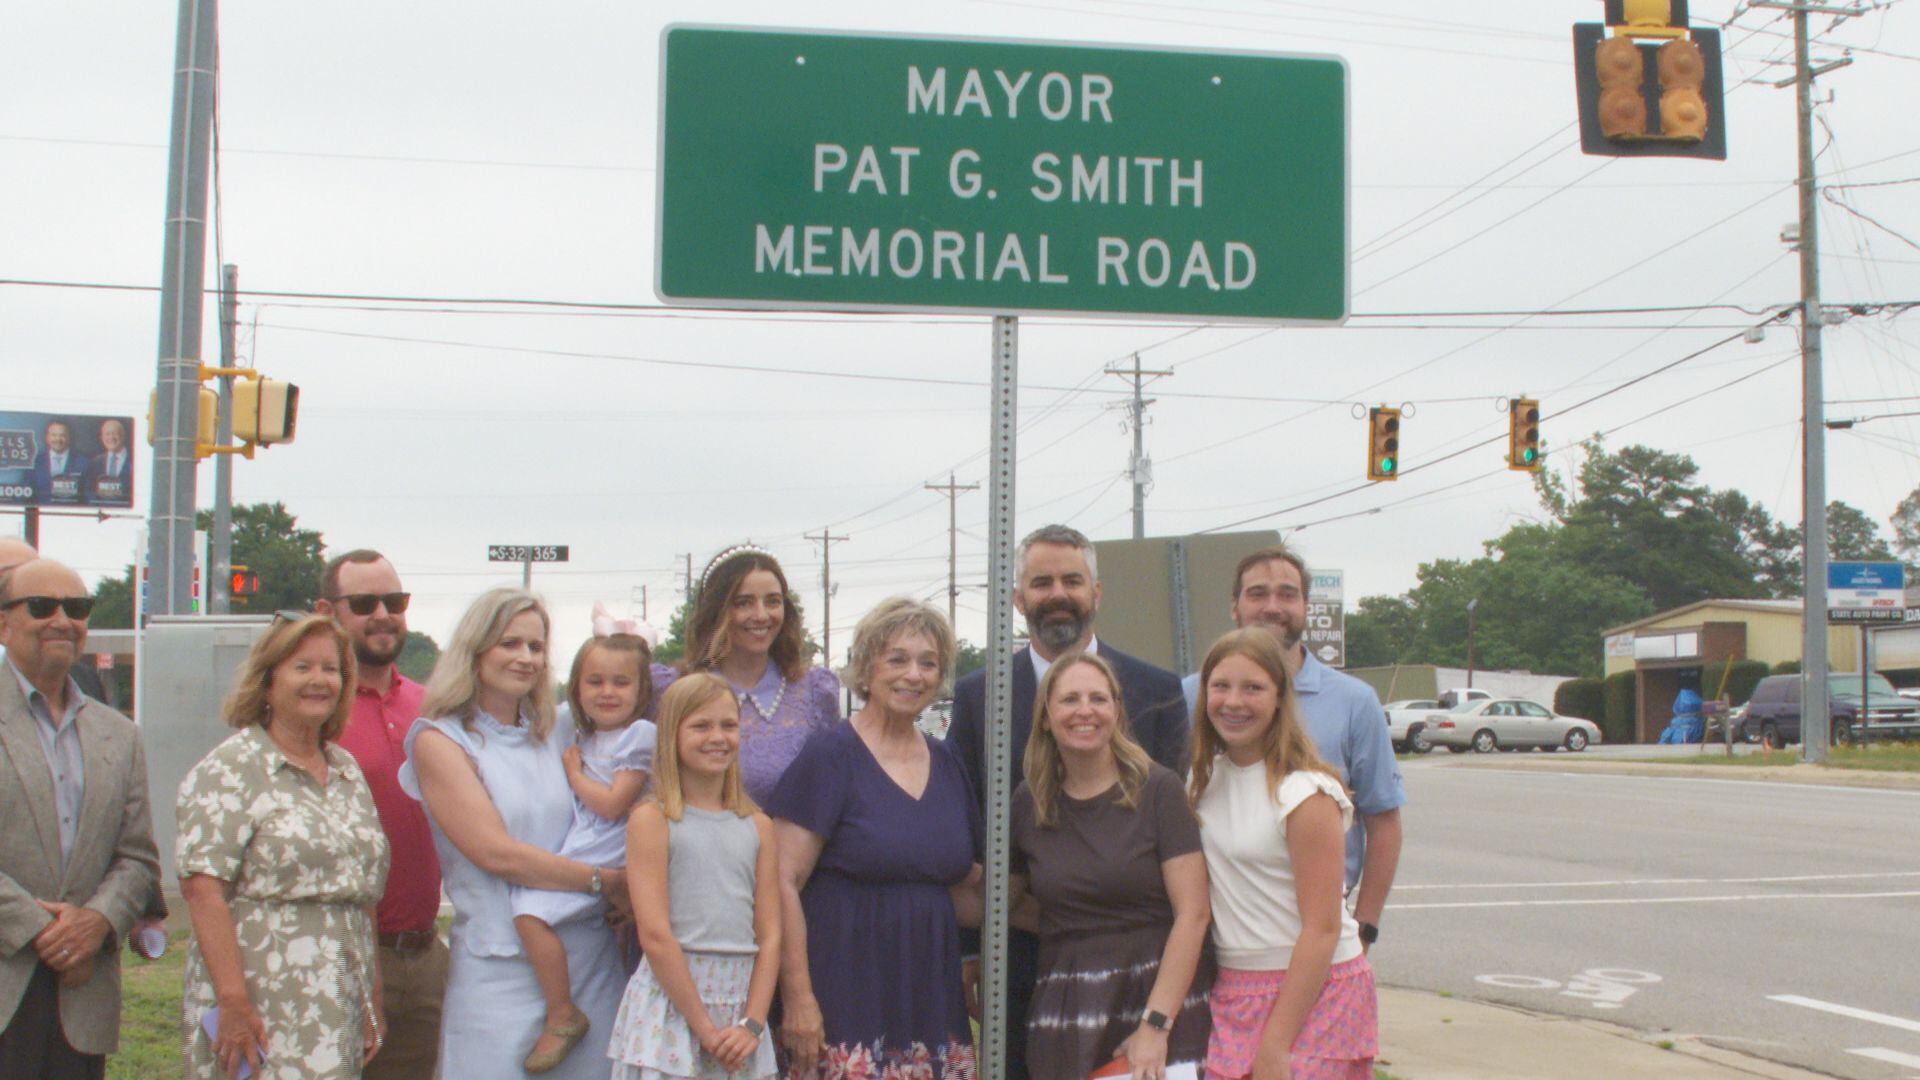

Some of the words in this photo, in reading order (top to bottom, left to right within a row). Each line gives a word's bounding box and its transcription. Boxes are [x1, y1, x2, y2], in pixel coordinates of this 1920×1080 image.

[907, 65, 1114, 123] MAYOR
[813, 143, 920, 195] PAT
[949, 149, 997, 199] G.
[1030, 152, 1203, 207] SMITH
[755, 223, 1069, 284] MEMORIAL
[1098, 236, 1257, 291] ROAD
[1311, 631, 1341, 641] REPAIR
